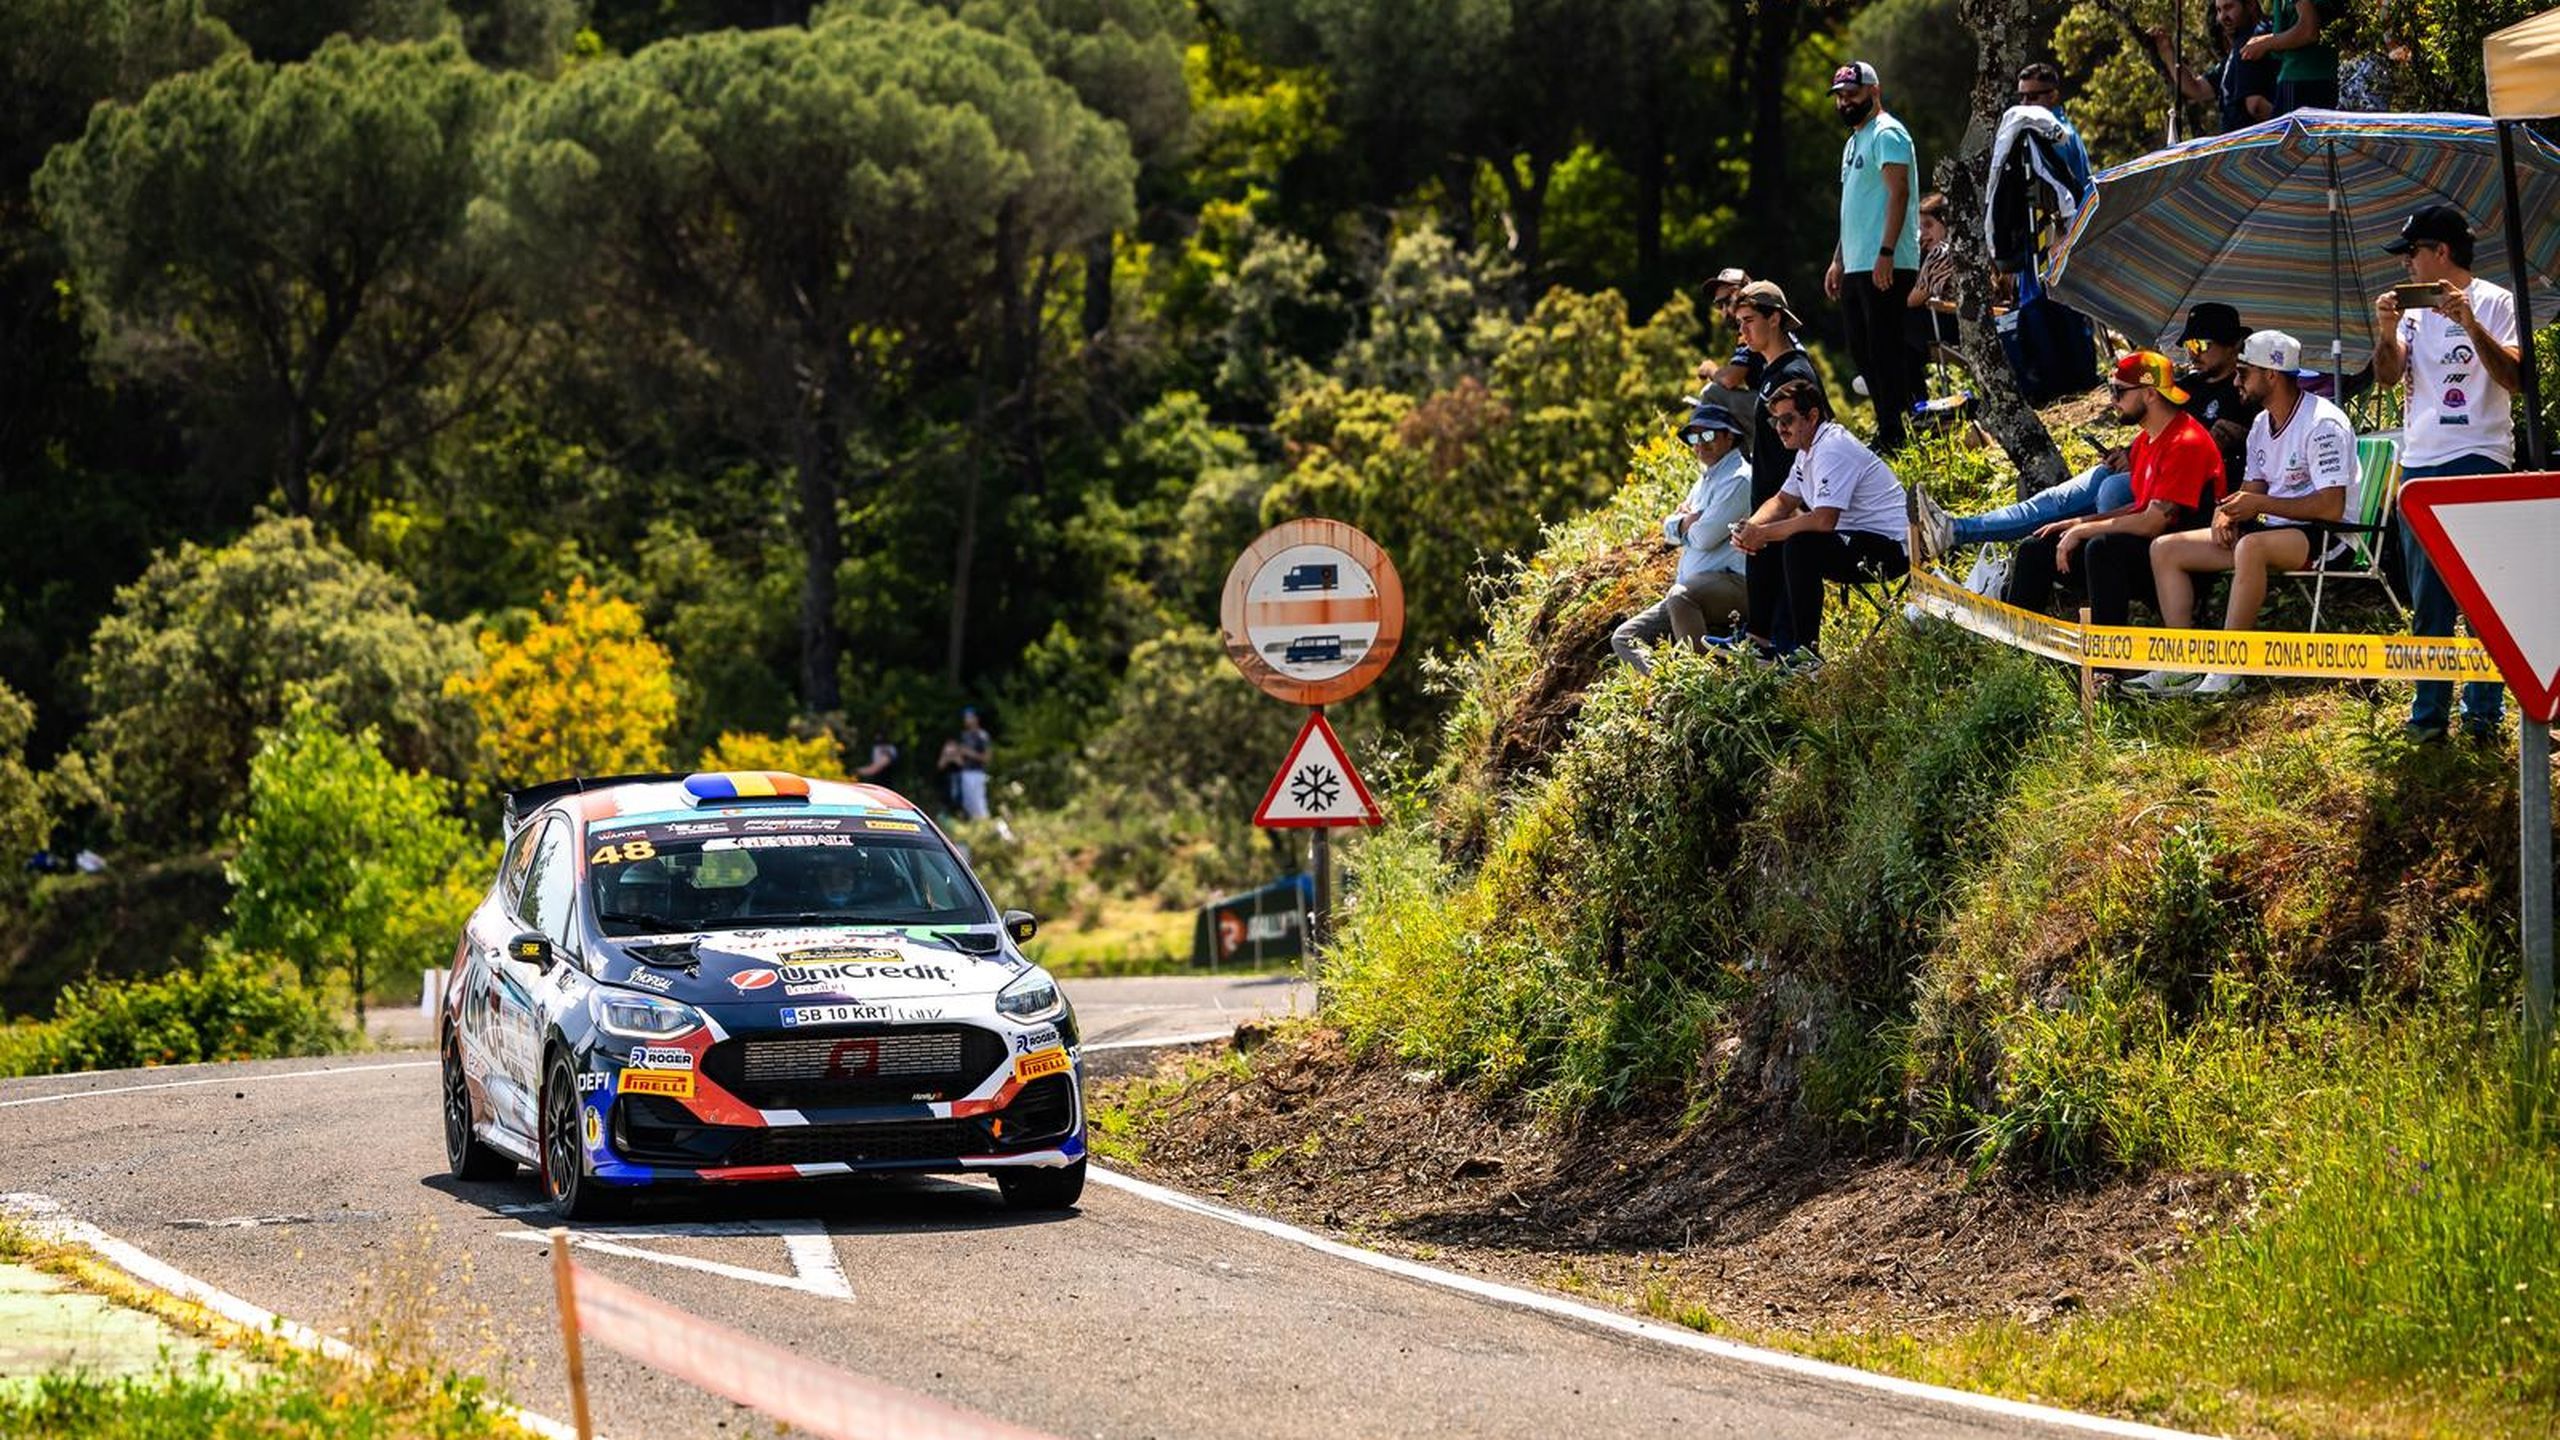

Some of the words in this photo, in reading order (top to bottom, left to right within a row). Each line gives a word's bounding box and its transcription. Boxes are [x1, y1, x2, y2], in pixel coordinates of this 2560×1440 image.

[2082, 633, 2132, 660] UBLICO
[2148, 637, 2185, 664] ZONA
[2189, 638, 2248, 666] PUBLICO
[2265, 641, 2302, 667] ZONA
[2306, 642, 2367, 669] PUBLICO
[2385, 643, 2424, 670] ZONA
[2428, 645, 2491, 672] PUBLICO
[591, 840, 656, 865] 48
[779, 964, 950, 983] UniCredit
[798, 1009, 822, 1022] SB
[828, 1008, 848, 1020] 10
[853, 1005, 889, 1019] KRT
[1030, 1031, 1060, 1046] ROGER
[648, 1054, 692, 1065] ROGER
[1020, 1051, 1067, 1077] PIRELLI
[578, 1072, 610, 1091] DEFI
[623, 1073, 687, 1093] PIRELLI
